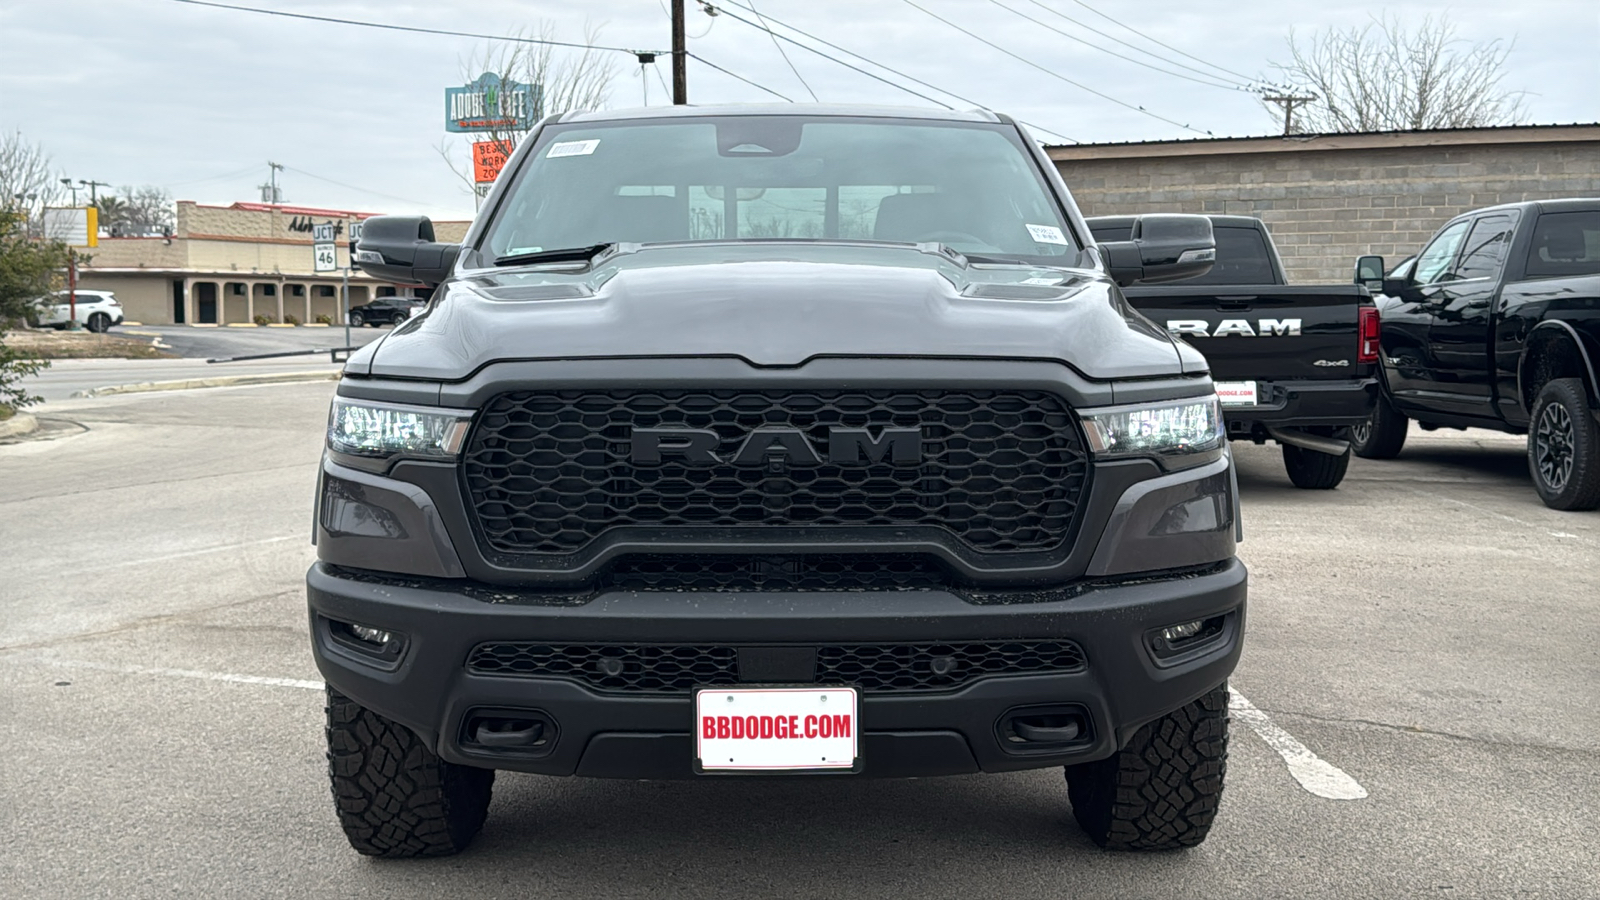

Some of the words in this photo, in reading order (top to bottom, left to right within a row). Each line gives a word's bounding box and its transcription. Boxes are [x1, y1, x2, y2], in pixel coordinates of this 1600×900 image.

[451, 92, 485, 120] ADOBE
[482, 156, 506, 166] WORK
[315, 226, 332, 239] JCT
[351, 225, 362, 238] JC
[318, 252, 333, 264] 46
[1167, 318, 1302, 337] RAM
[1313, 359, 1349, 367] 4x4
[631, 427, 922, 464] RAM
[703, 714, 851, 740] BBDODGE.COM
